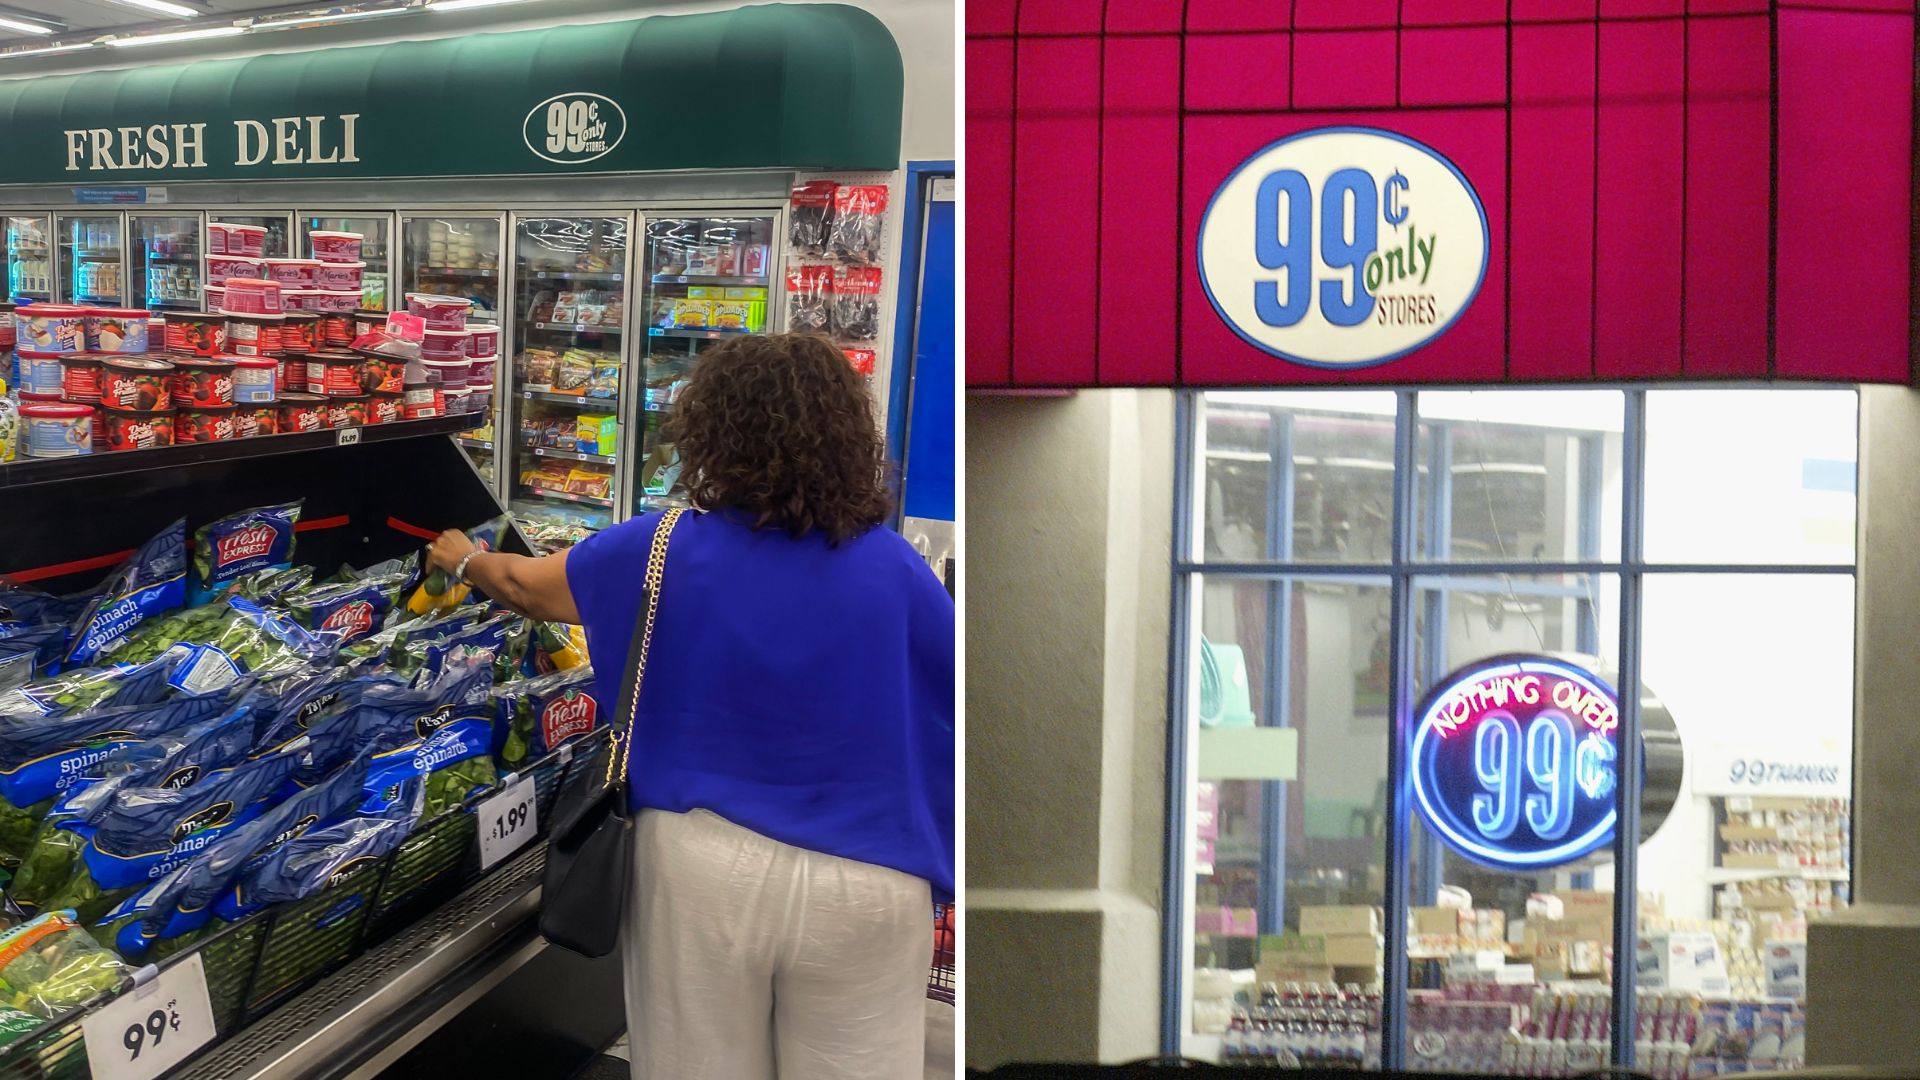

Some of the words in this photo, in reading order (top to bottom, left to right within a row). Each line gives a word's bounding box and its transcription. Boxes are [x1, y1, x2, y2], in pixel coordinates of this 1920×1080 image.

[64, 122, 207, 171] FRESH
[234, 113, 360, 166] DELI
[582, 119, 607, 141] only
[585, 140, 606, 152] STORES
[1366, 224, 1436, 293] only
[1377, 294, 1437, 326] STORES
[341, 434, 356, 444] $1.99
[223, 543, 267, 560] EXPRESS
[91, 598, 139, 634] pinach
[548, 697, 588, 730] Fresh
[1431, 675, 1541, 738] NOTHING
[1552, 680, 1619, 738] OVER
[550, 718, 589, 744] EXPRESS
[492, 802, 528, 839] $1.99
[123, 1009, 181, 1062] 99¢
